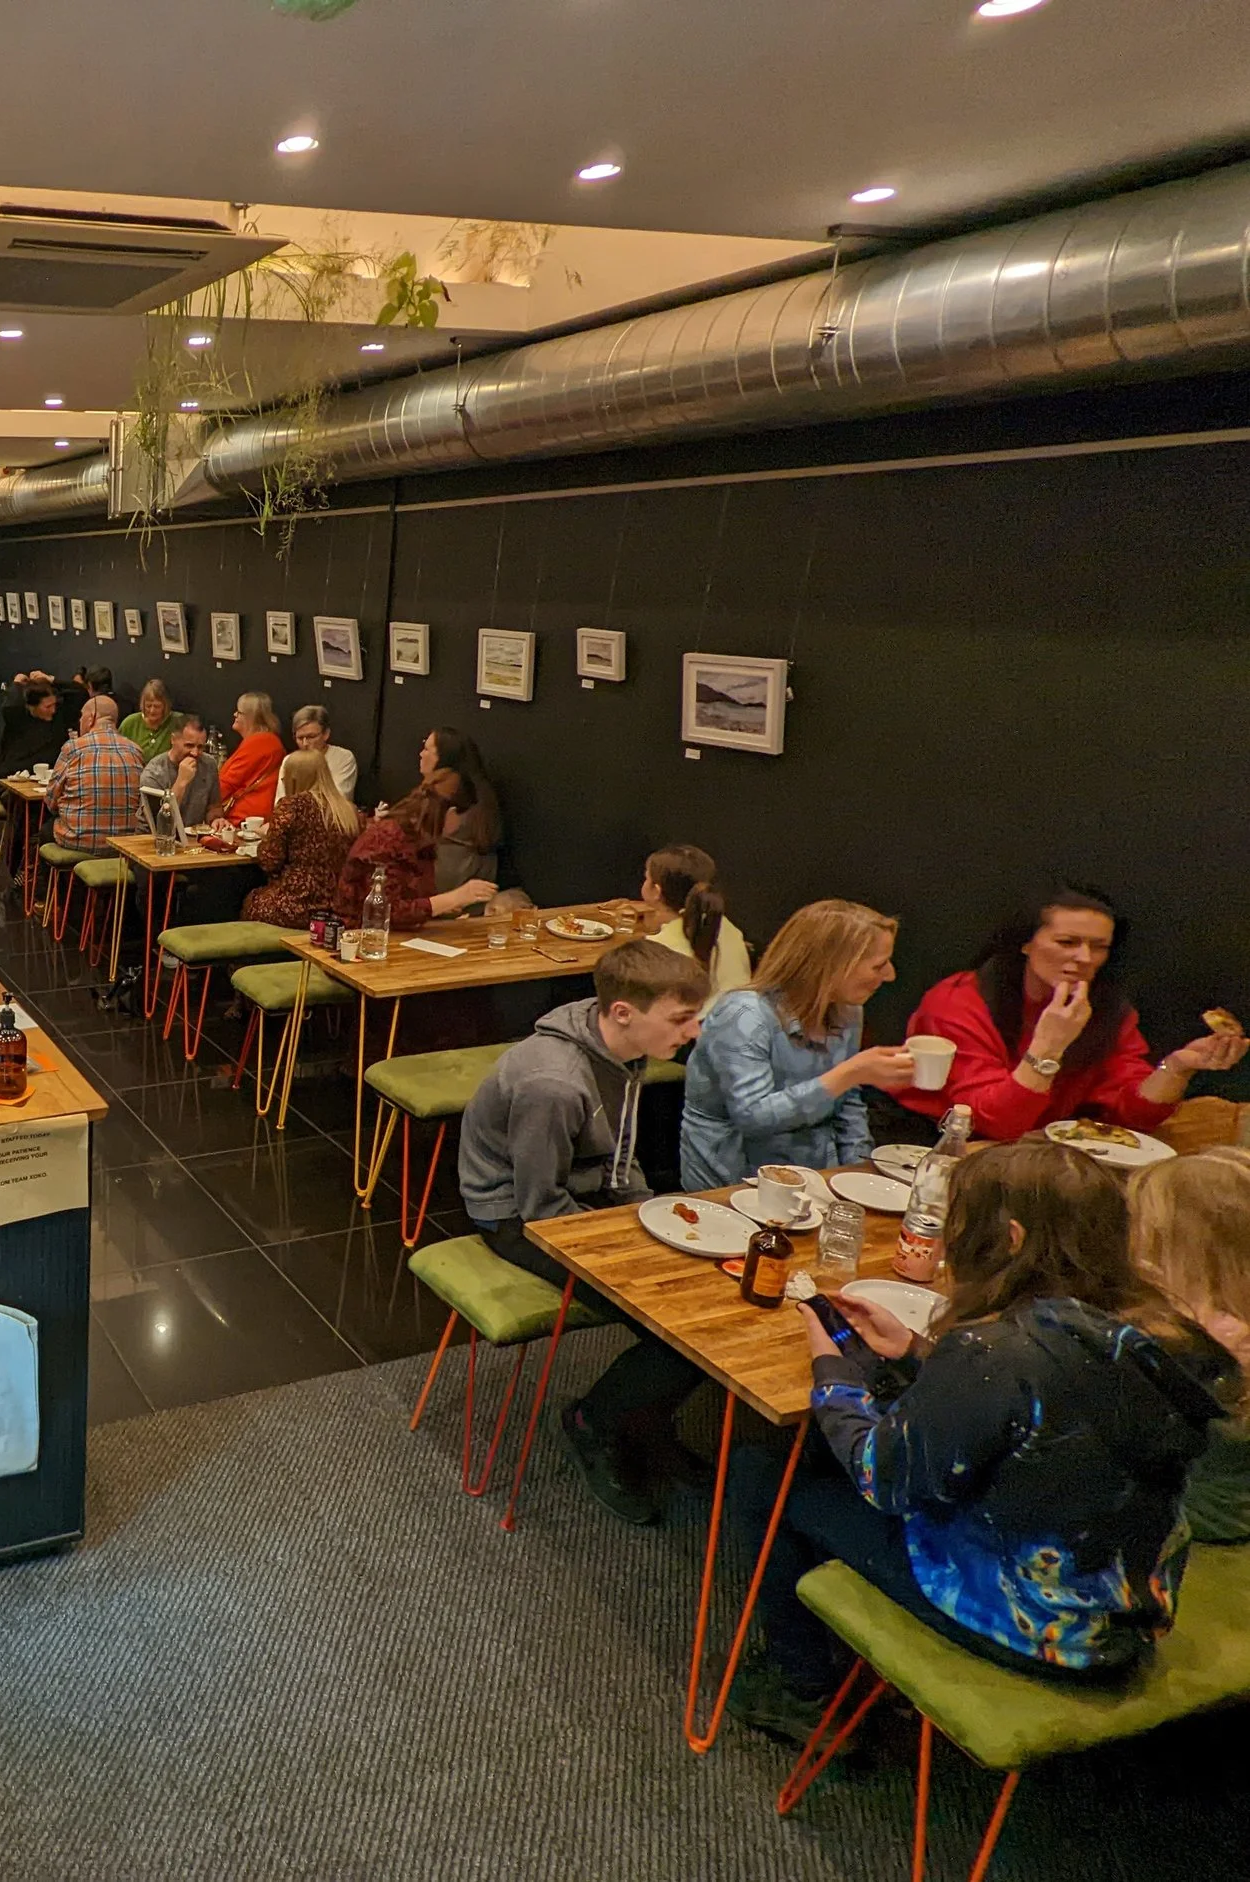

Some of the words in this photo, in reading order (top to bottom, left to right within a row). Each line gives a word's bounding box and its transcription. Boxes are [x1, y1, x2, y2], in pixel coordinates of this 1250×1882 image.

[1, 1134, 29, 1144] STAFFED
[11, 1146, 41, 1156] PATIENCE
[31, 1151, 48, 1159] YOUR
[11, 1175, 29, 1184] TEAM
